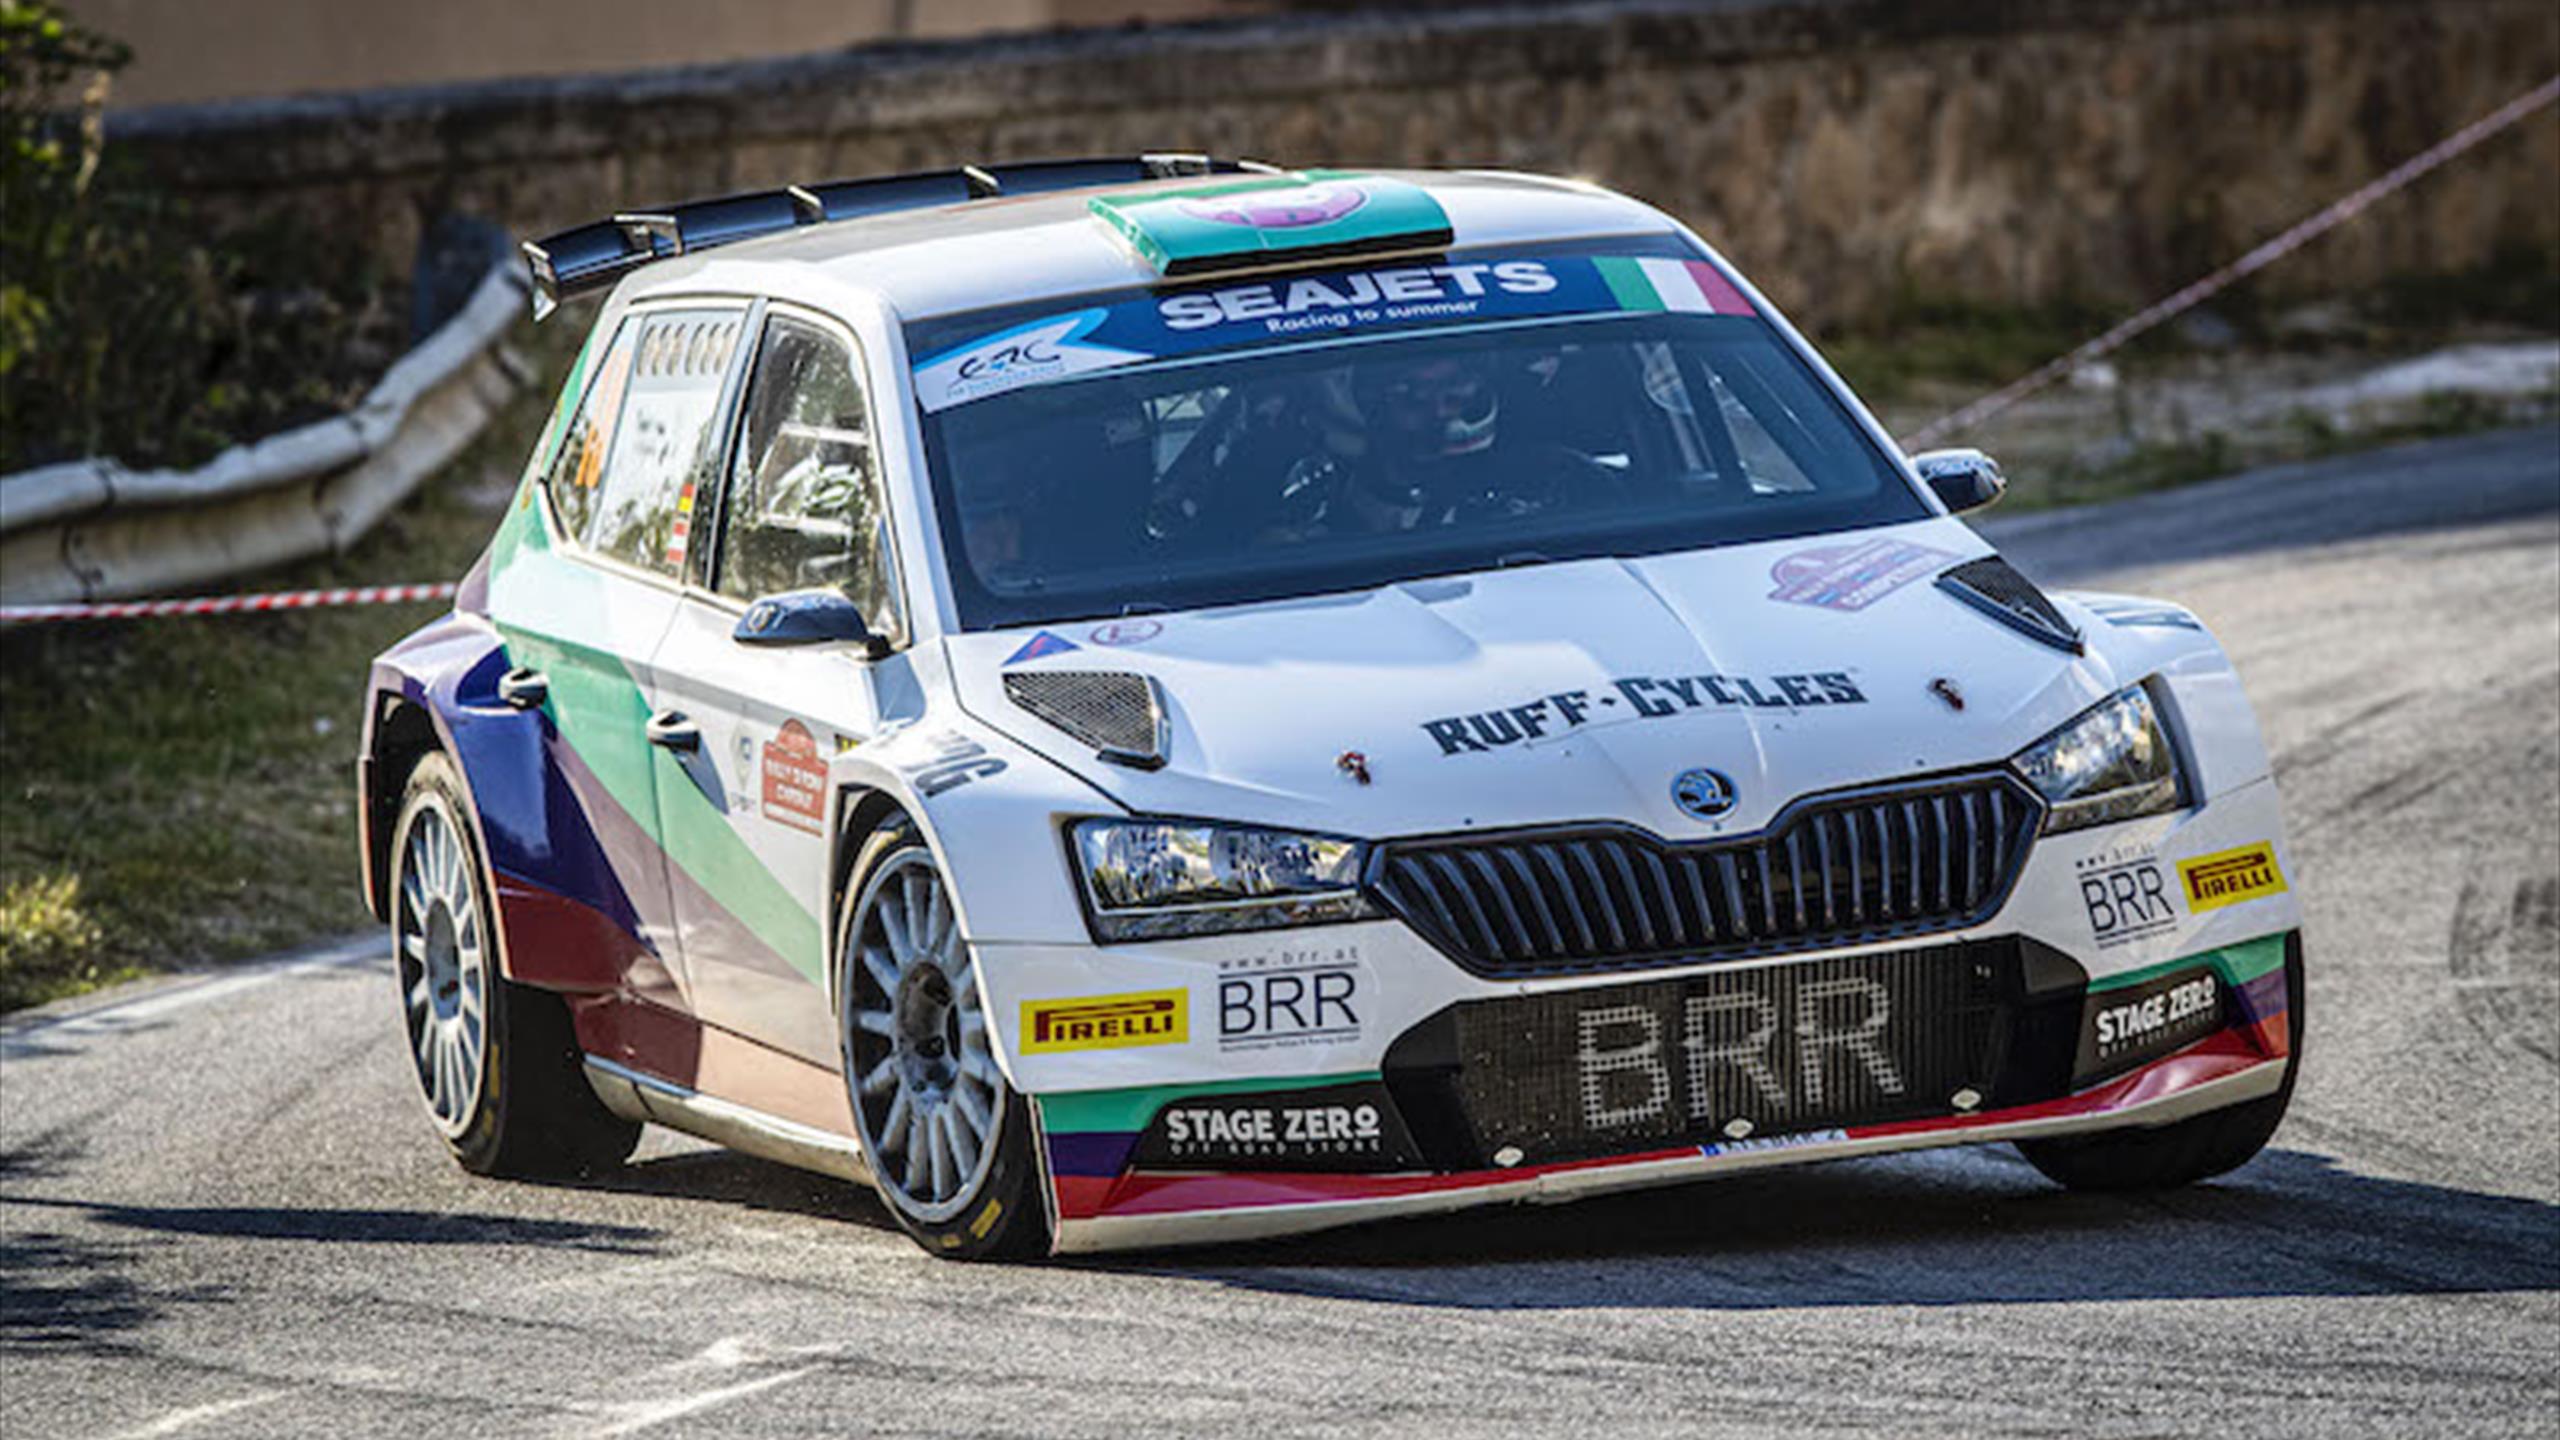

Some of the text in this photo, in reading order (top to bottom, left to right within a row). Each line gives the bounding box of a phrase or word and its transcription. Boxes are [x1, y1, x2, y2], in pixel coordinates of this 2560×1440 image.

[1159, 261, 1558, 330] SEAJETS
[1265, 301, 1479, 333] Racing to summer
[2081, 865, 2174, 933] BRR
[2186, 852, 2274, 900] PIRELLI
[1035, 1000, 1175, 1042] PIRELLI
[1220, 972, 1359, 1035] BRR
[2096, 994, 2166, 1043] STAGE
[2168, 975, 2216, 1021] ZERO
[1578, 977, 1904, 1130] BRR
[1166, 1104, 1380, 1142] STAGE ZERO
